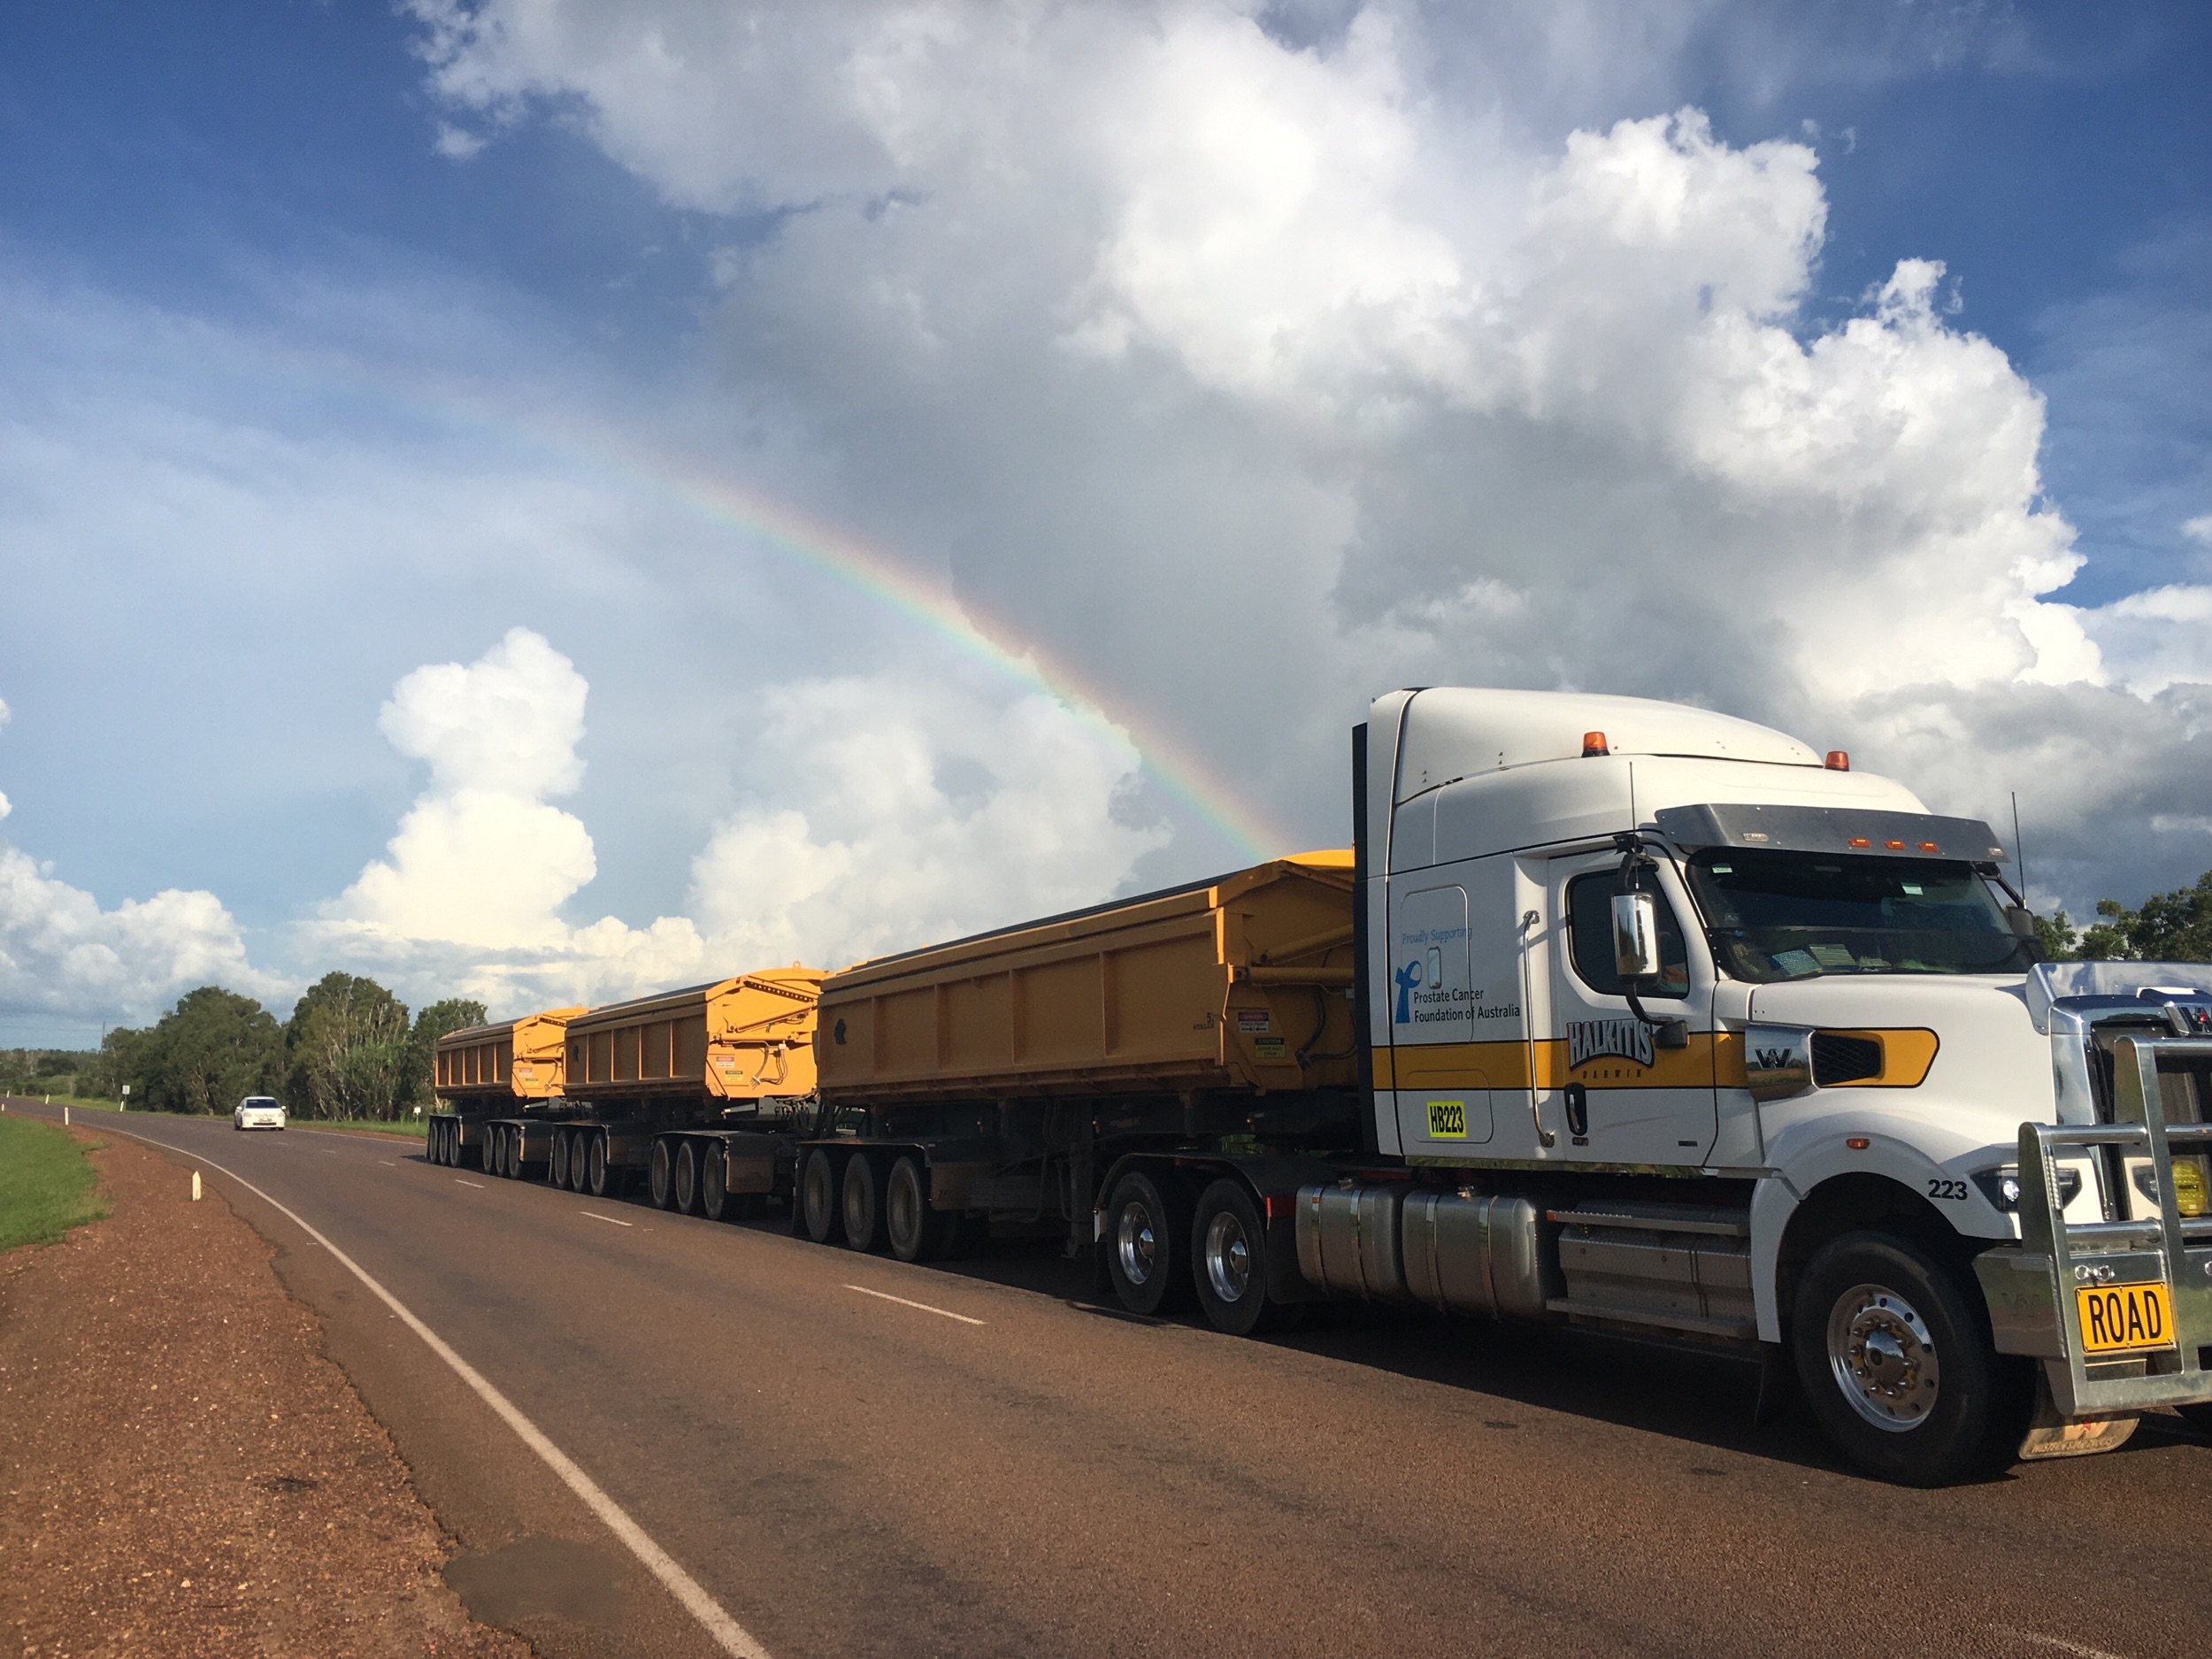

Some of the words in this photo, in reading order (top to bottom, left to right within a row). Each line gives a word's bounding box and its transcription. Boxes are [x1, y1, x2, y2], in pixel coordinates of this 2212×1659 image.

[1402, 929, 1429, 946] Proudly
[1431, 926, 1473, 943] Supporting
[1413, 990, 1450, 1004] Prostate
[1452, 987, 1485, 1002] Cancer
[1414, 1008, 1463, 1023] Foundation
[1465, 1006, 1475, 1020] of
[1477, 1003, 1521, 1019] Australia
[1566, 1018, 1655, 1071] HALKITIS
[1582, 1069, 1642, 1079] DARWIN
[1430, 1105, 1463, 1133] HB223
[1927, 1179, 1968, 1201] 223
[2087, 1290, 2162, 1345] ROAD
